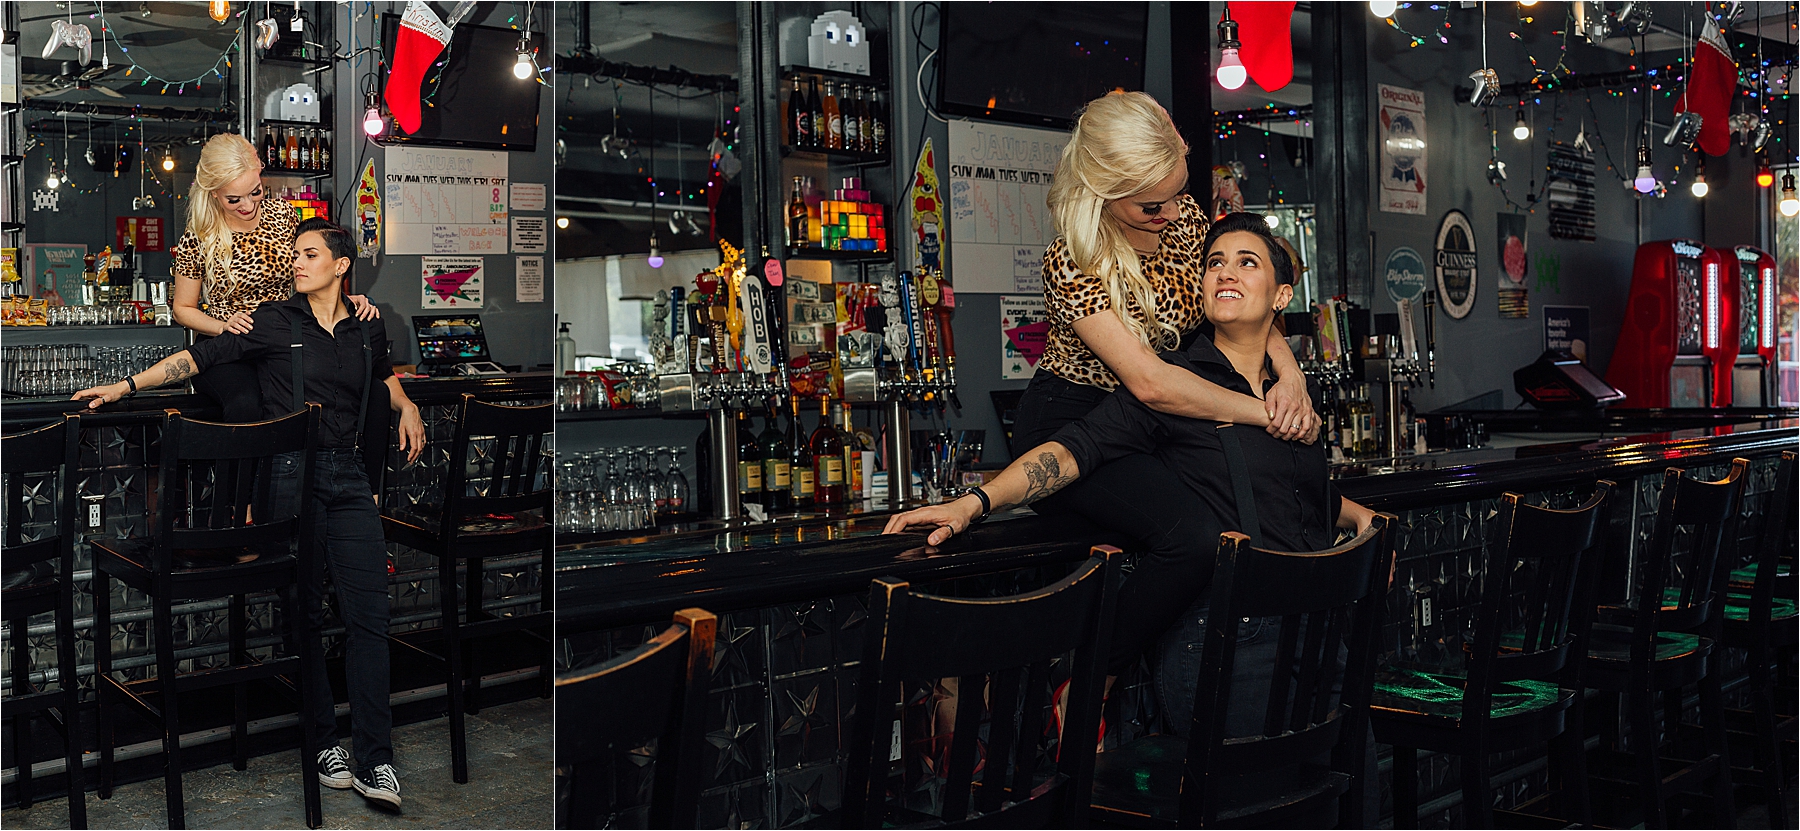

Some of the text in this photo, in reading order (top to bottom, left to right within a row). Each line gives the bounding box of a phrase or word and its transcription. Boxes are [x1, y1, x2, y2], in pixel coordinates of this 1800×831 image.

[408, 4, 445, 37] Kristin
[1381, 87, 1422, 105] ORIGINAL
[971, 131, 1063, 165] JANUARY
[402, 152, 474, 172] JANUARY
[386, 174, 402, 182] SUN
[404, 175, 420, 183] MON
[423, 175, 437, 184] TUES
[440, 176, 455, 184] WED
[473, 177, 488, 185] FRI
[491, 178, 506, 186] SAT
[951, 165, 973, 178] SUN
[975, 166, 996, 180] MON
[998, 168, 1018, 182] TUES
[1020, 171, 1040, 184] WED
[492, 187, 500, 203] 8
[489, 204, 504, 212] BIT
[468, 240, 493, 251] BACK
[1437, 250, 1476, 269] GUINNESS
[1387, 268, 1402, 285] Big
[750, 291, 765, 338] HOB
[908, 283, 922, 348] BUD LIGHT
